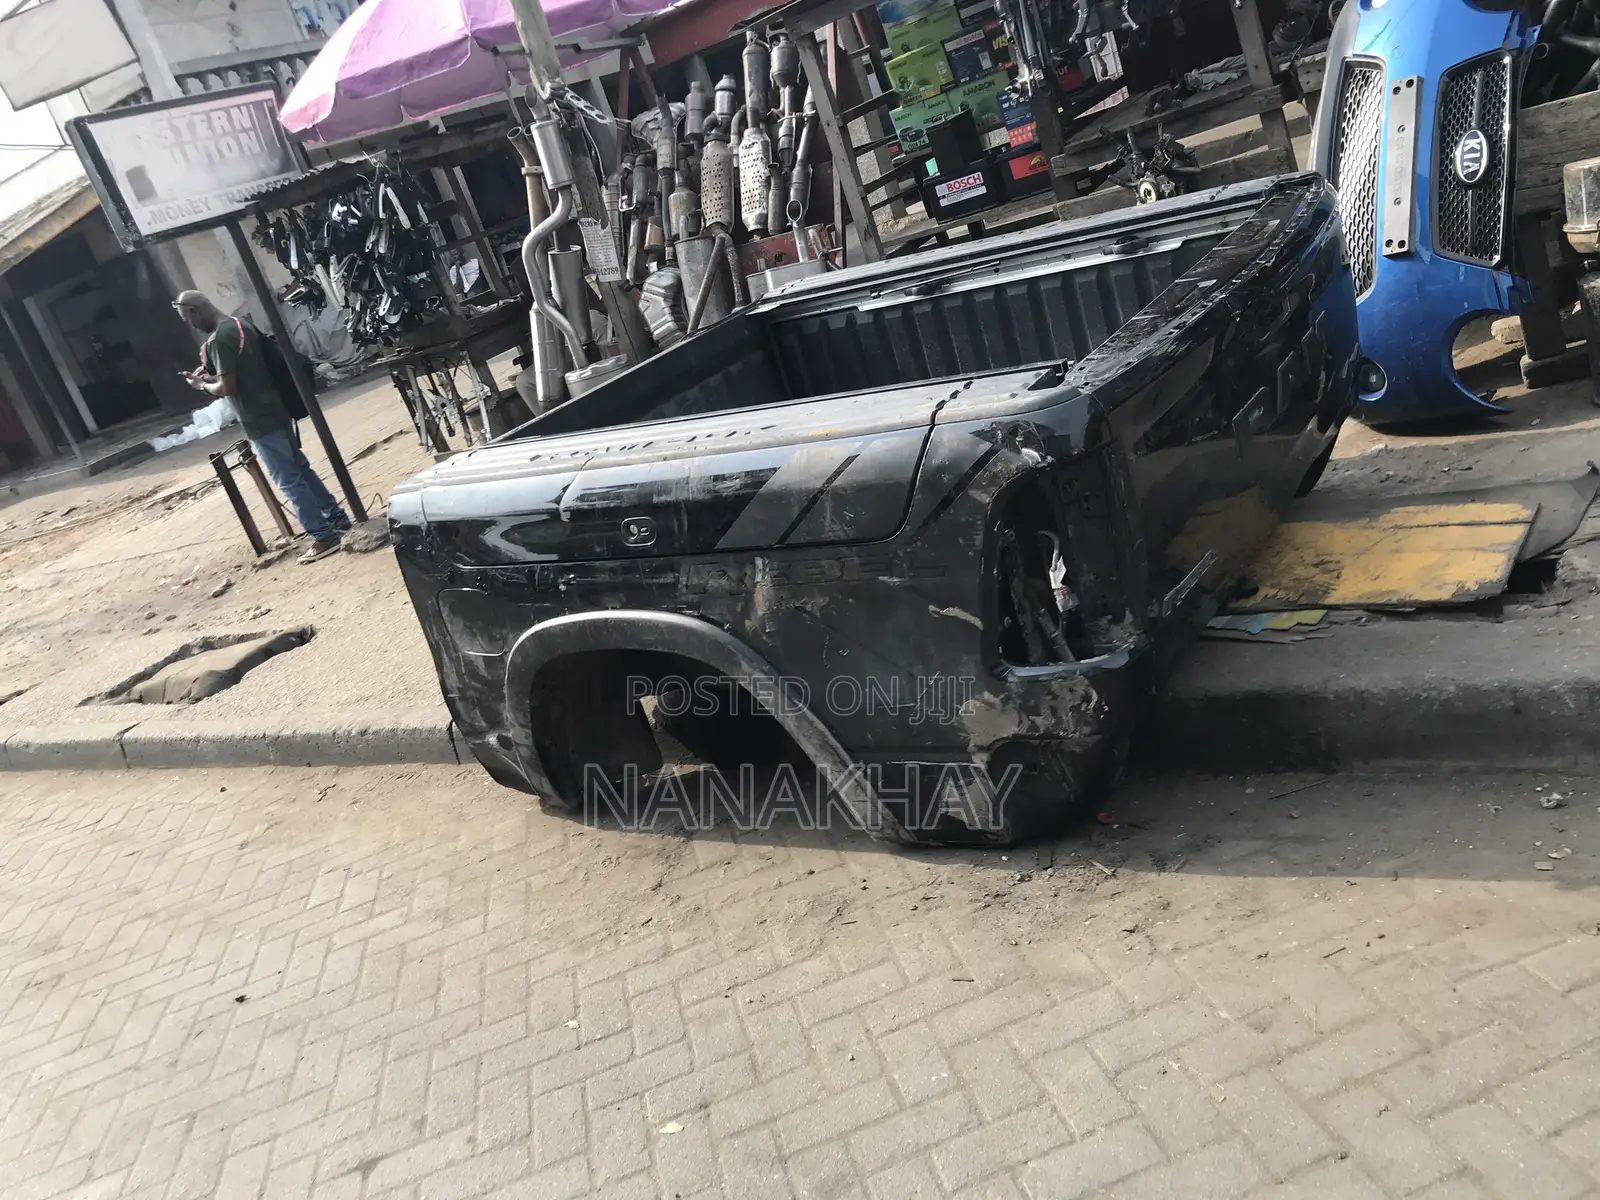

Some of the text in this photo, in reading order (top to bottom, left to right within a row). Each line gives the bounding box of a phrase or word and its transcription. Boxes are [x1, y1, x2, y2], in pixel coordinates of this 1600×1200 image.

[130, 104, 254, 150] STERN
[1463, 137, 1481, 176] KIA
[946, 173, 983, 193] BOSCH
[150, 197, 212, 225] MONEY
